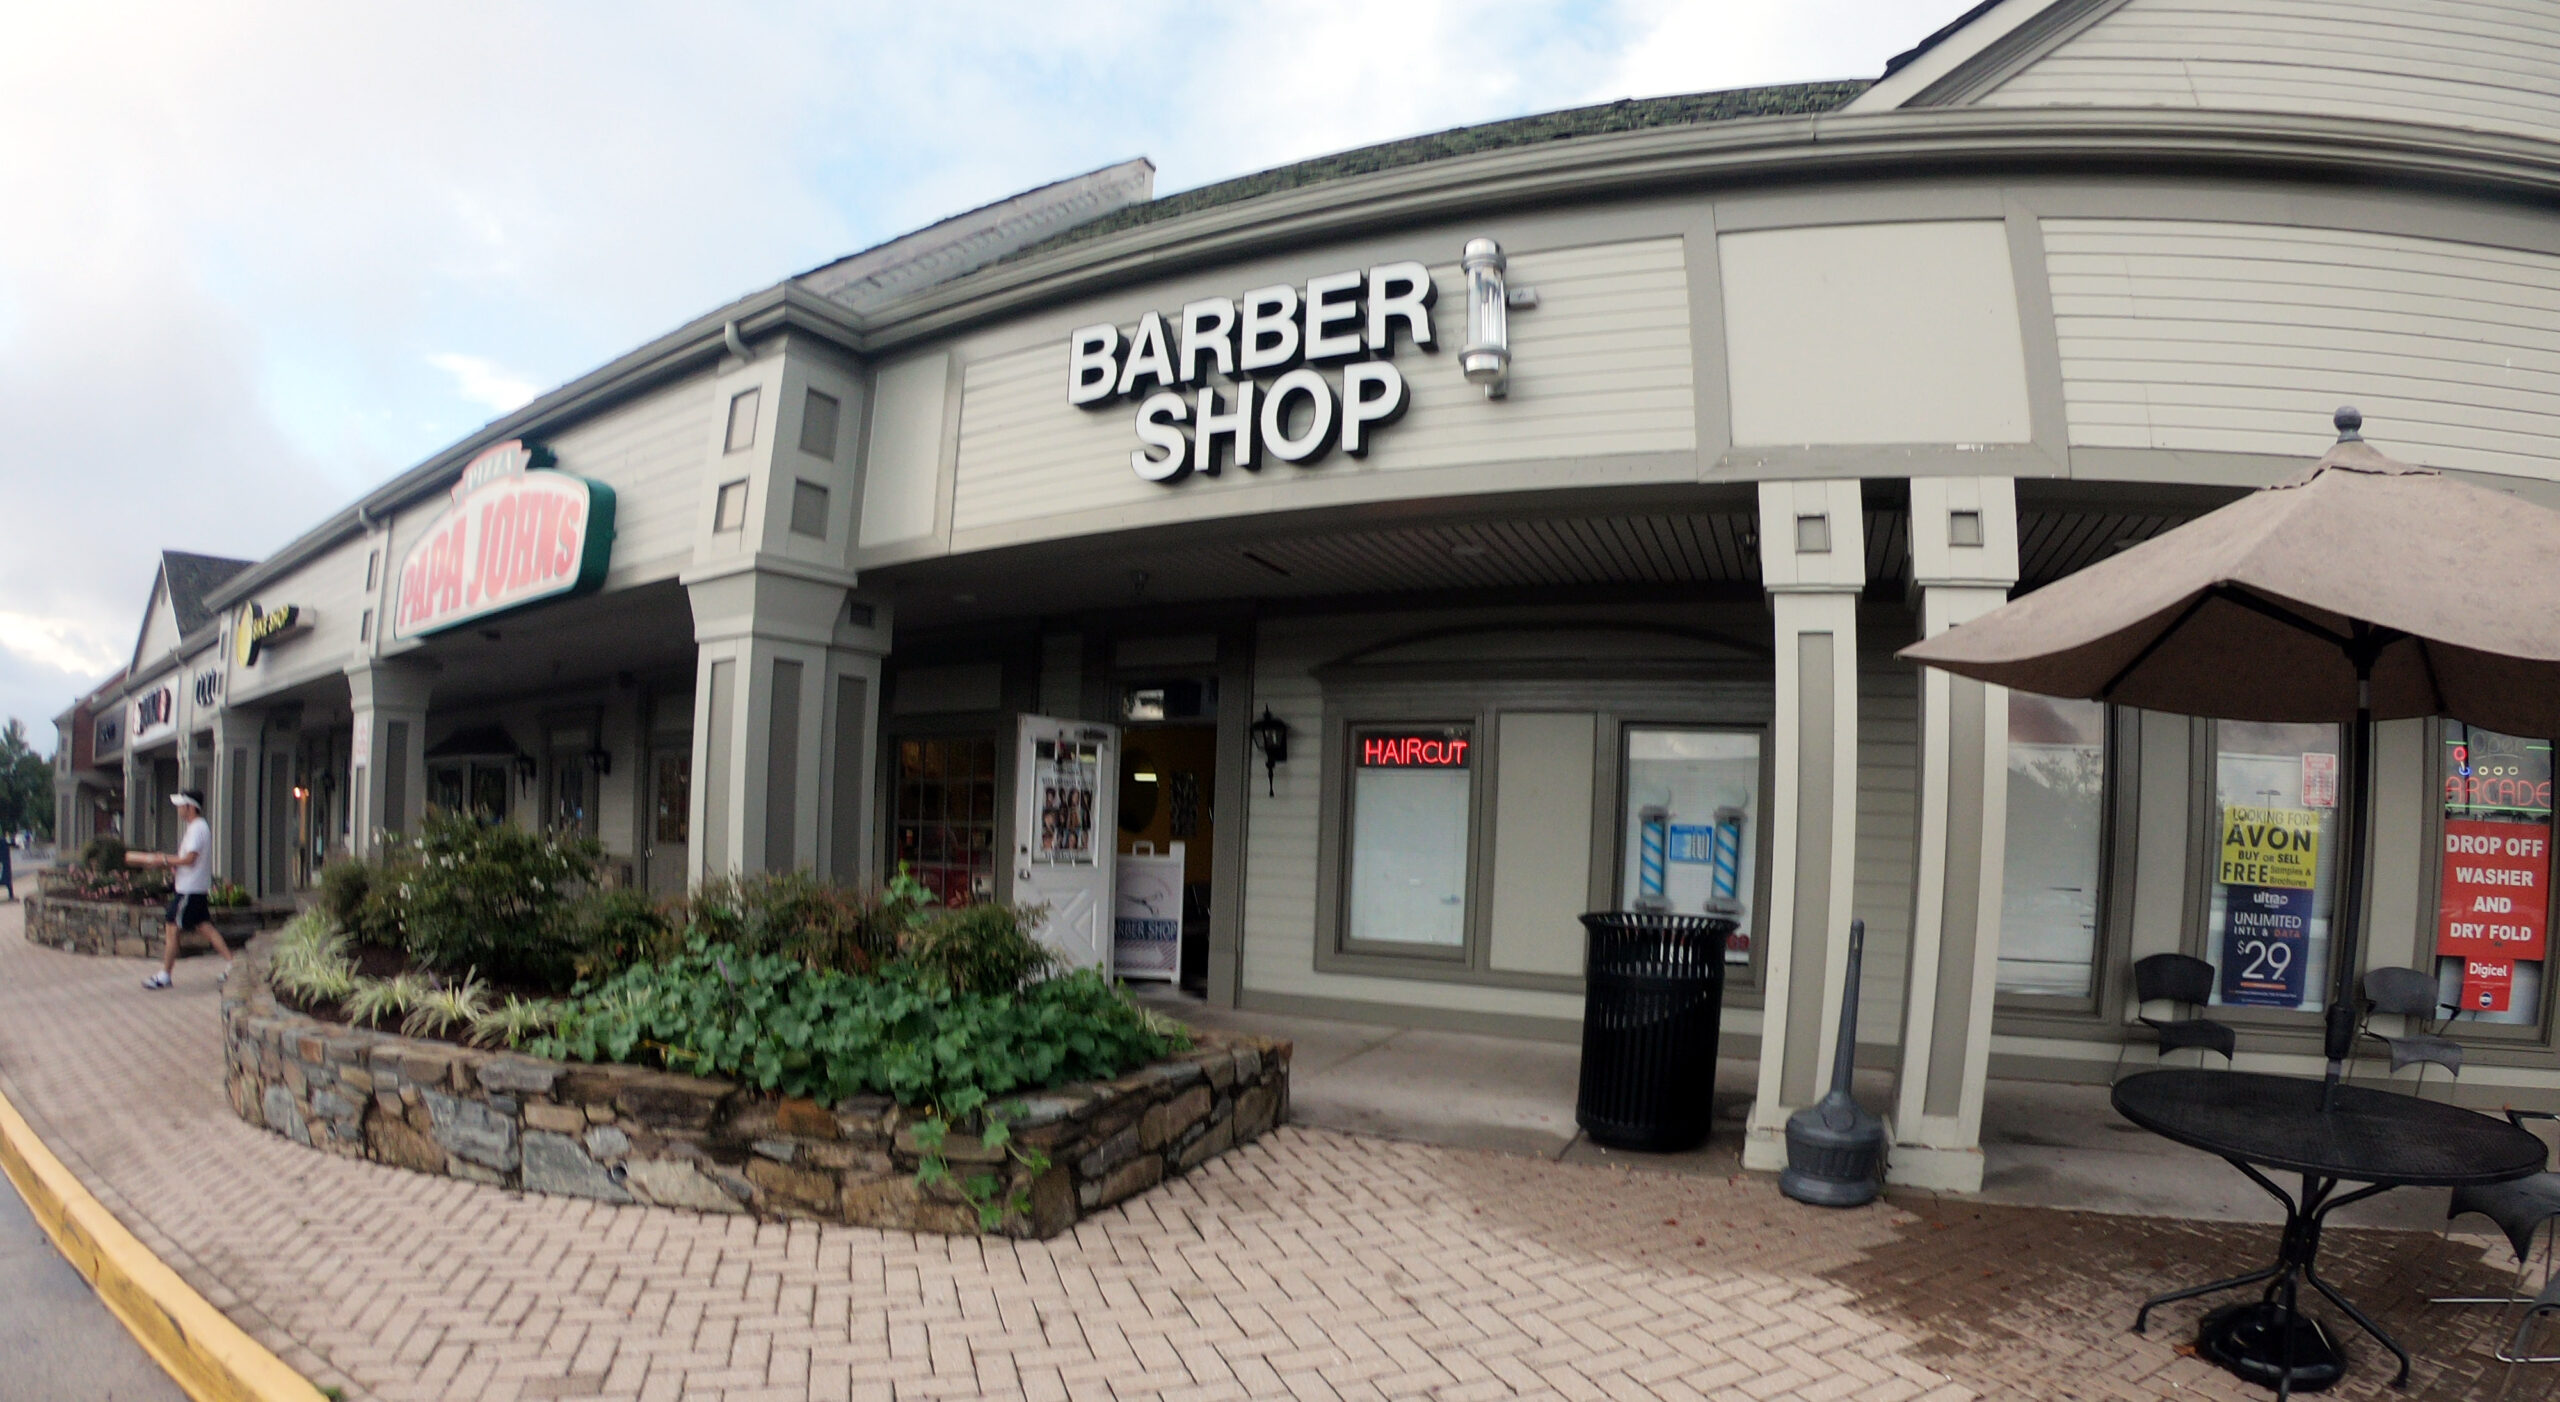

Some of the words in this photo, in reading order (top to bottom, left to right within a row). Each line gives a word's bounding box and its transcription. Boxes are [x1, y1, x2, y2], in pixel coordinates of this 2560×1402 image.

[1067, 260, 1438, 410] BARBER
[1130, 360, 1410, 484] SHOP
[400, 515, 467, 627] PAPA
[1364, 736, 1469, 766] HAIRCUT
[2445, 776, 2552, 808] ARCADE
[2232, 807, 2284, 825] LOOKING
[2287, 814, 2310, 826] FOR
[2226, 823, 2311, 852] AVON
[2446, 834, 2502, 856] DROP
[2505, 837, 2543, 858] OFF
[2238, 849, 2260, 860] BUY
[2277, 854, 2301, 865] SELL
[2222, 862, 2269, 883] FREE
[2455, 866, 2534, 887] WASHER
[2472, 896, 2512, 914] AND
[2234, 911, 2302, 929] UNLIMITED
[1148, 920, 1177, 942] SHOP
[2233, 926, 2257, 936] INTL
[2261, 928, 2269, 937] &
[2273, 929, 2302, 938] DATA
[2450, 922, 2485, 939] DRY
[2489, 924, 2532, 941] FOLD
[2469, 962, 2507, 978] Digicel
